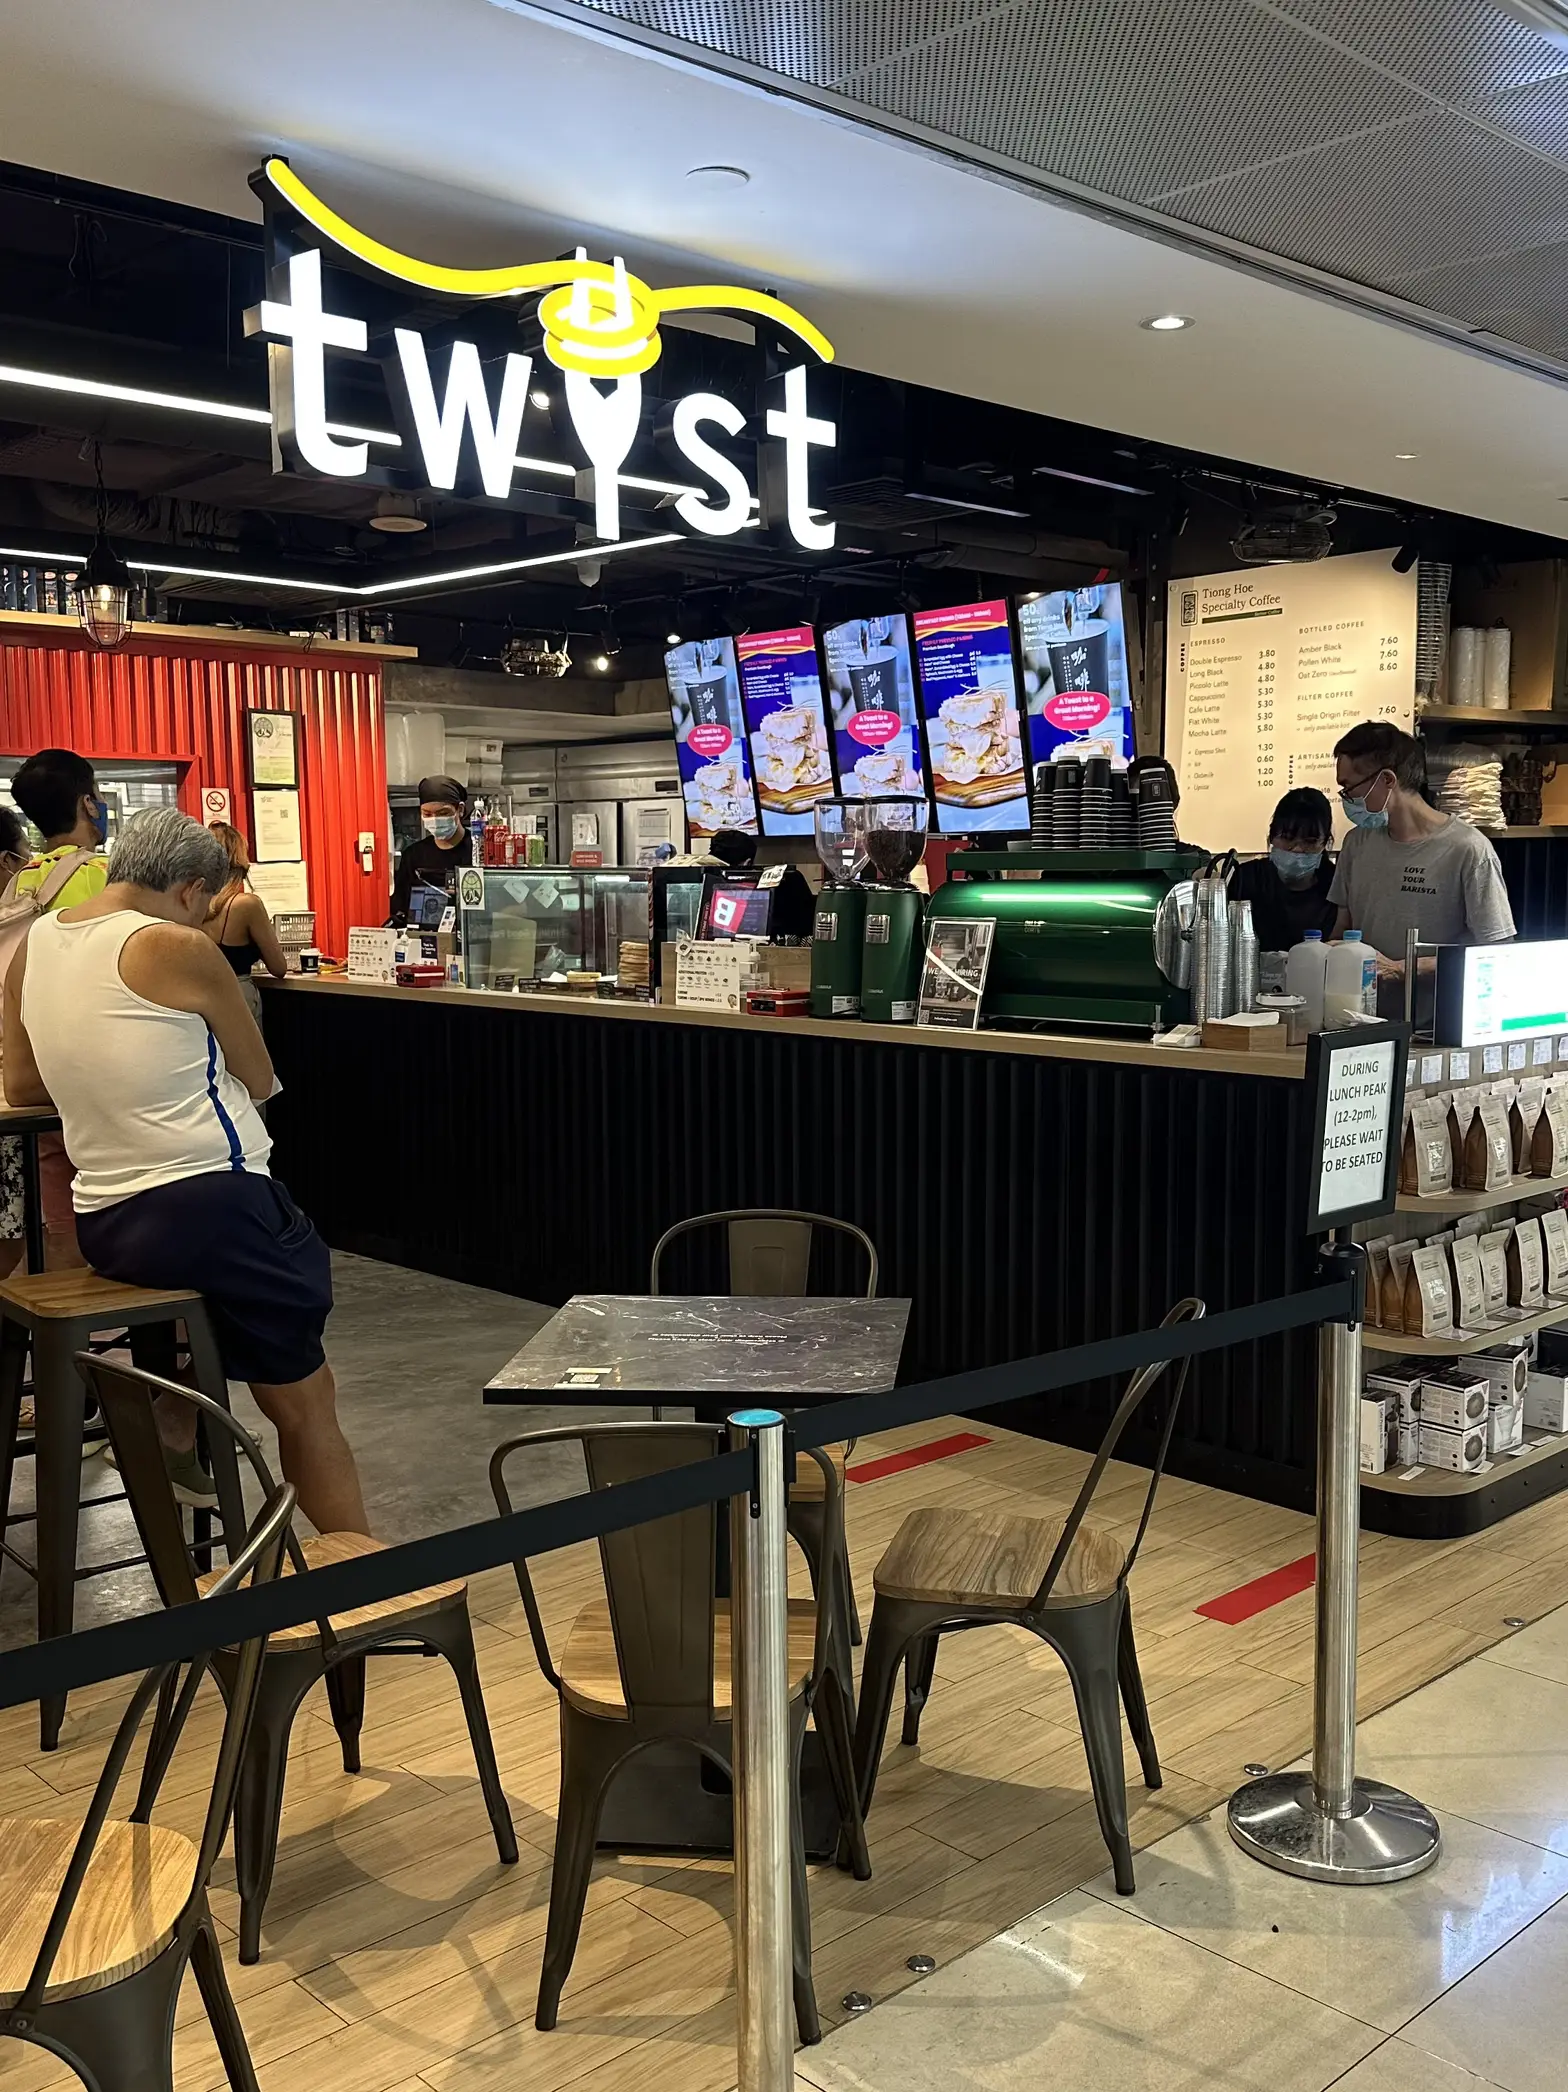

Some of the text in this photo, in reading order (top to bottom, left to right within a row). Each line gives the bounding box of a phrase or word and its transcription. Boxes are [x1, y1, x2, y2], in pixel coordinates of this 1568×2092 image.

[1202, 584, 1254, 598] Tiong Hoe
[1202, 600, 1246, 614] Specialty
[1250, 594, 1280, 606] Coffee
[1299, 621, 1364, 634] BOTTLED COFFEE
[1190, 638, 1226, 647] ESPRESSO
[1380, 636, 1398, 646] 7.60
[1324, 643, 1342, 652] Black
[1259, 650, 1276, 659] 3.80
[1380, 650, 1398, 659] 7.60
[1190, 655, 1242, 666] Double Espresso
[1299, 658, 1319, 667] Pollen
[1258, 662, 1275, 671] 4.80
[1379, 663, 1397, 671] 8.60
[1258, 674, 1274, 683] 4.80
[1190, 682, 1211, 690] Piccolo
[1258, 687, 1274, 696] 5.30
[1325, 690, 1353, 699] COFFEE
[1189, 693, 1226, 702] Cappuccino
[1258, 700, 1273, 708] 5.30
[1378, 706, 1397, 715] 7.60
[1257, 712, 1273, 720] 5.30
[1297, 713, 1318, 722] Single
[1320, 711, 1340, 720] Origin
[1257, 724, 1273, 733] 5.80
[1401, 885, 1436, 894] BARISTA
[1342, 1060, 1379, 1077] DURING
[1330, 1082, 1387, 1102] LUNCH PEAK
[1334, 1105, 1378, 1126] (12-2pm),
[1324, 1129, 1384, 1150] PLEASE WAIT
[1335, 1158, 1347, 1170] BE
[1349, 1151, 1382, 1168] SEATED
